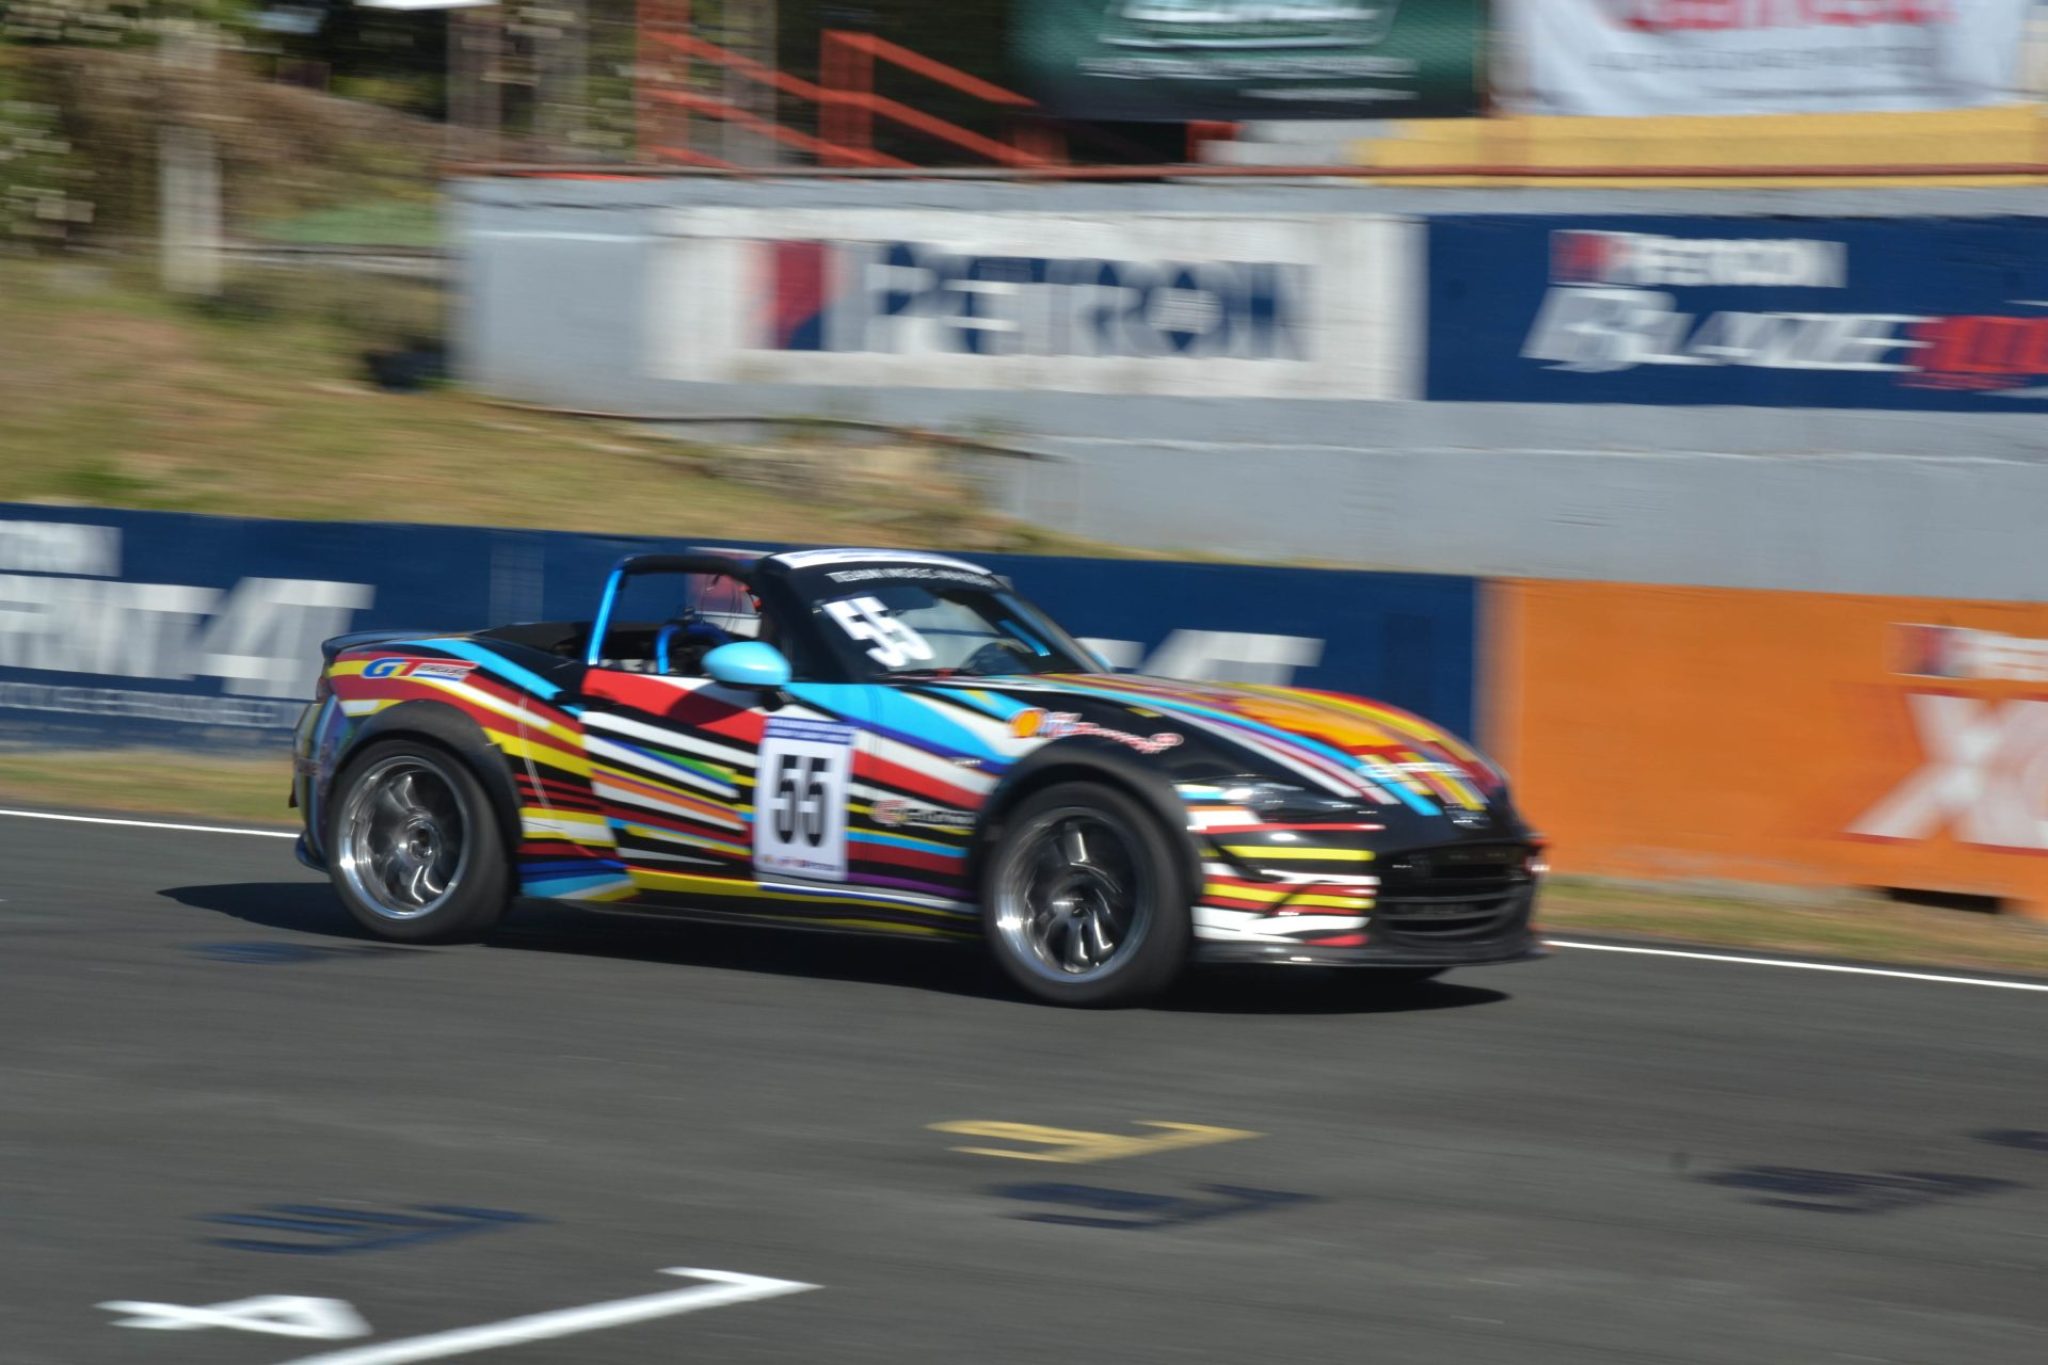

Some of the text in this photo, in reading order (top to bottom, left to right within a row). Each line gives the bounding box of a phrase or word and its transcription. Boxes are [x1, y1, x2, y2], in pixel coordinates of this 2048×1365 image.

[856, 241, 1310, 360] PETRON
[821, 596, 935, 667] 55
[773, 754, 832, 847] 55
